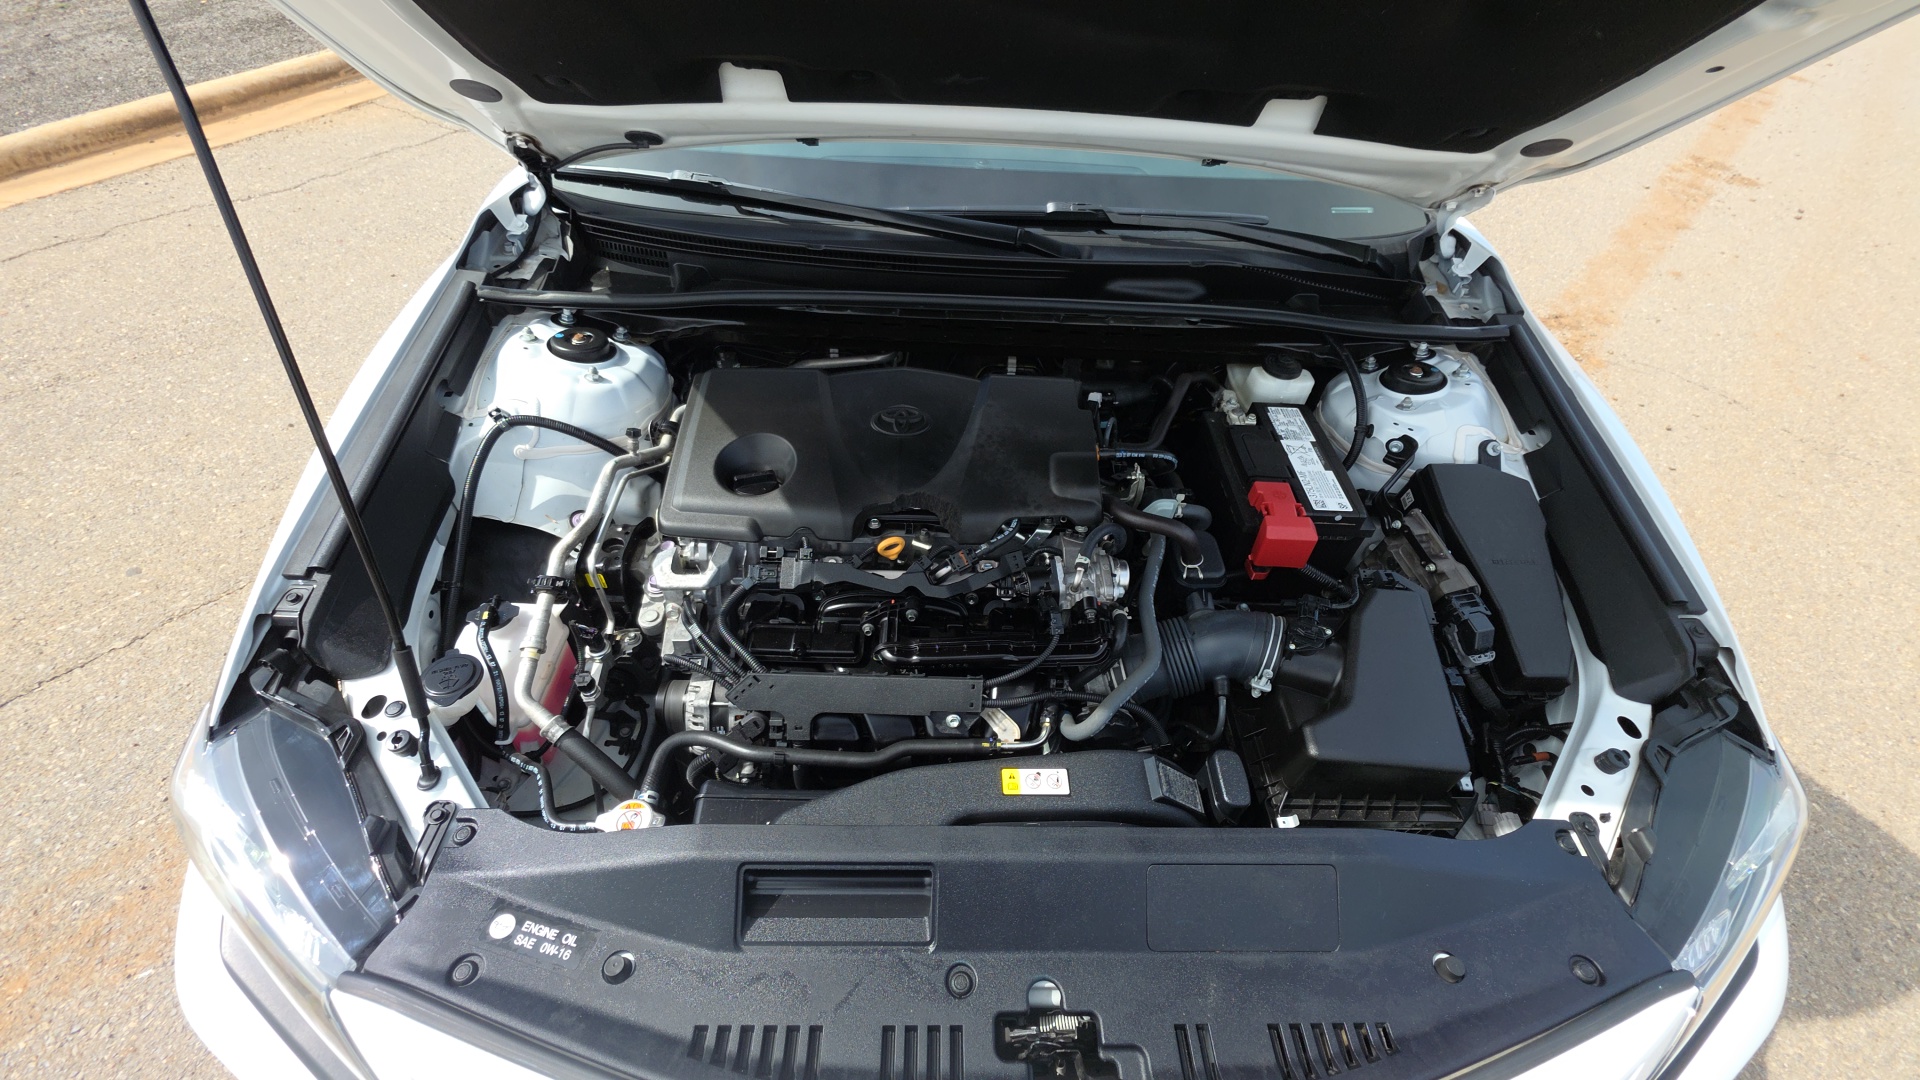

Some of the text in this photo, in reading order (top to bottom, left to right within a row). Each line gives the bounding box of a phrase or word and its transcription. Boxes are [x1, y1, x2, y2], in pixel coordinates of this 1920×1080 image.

[521, 920, 578, 947] ENGINE OIL
[513, 934, 572, 960] SAE 0W-16
